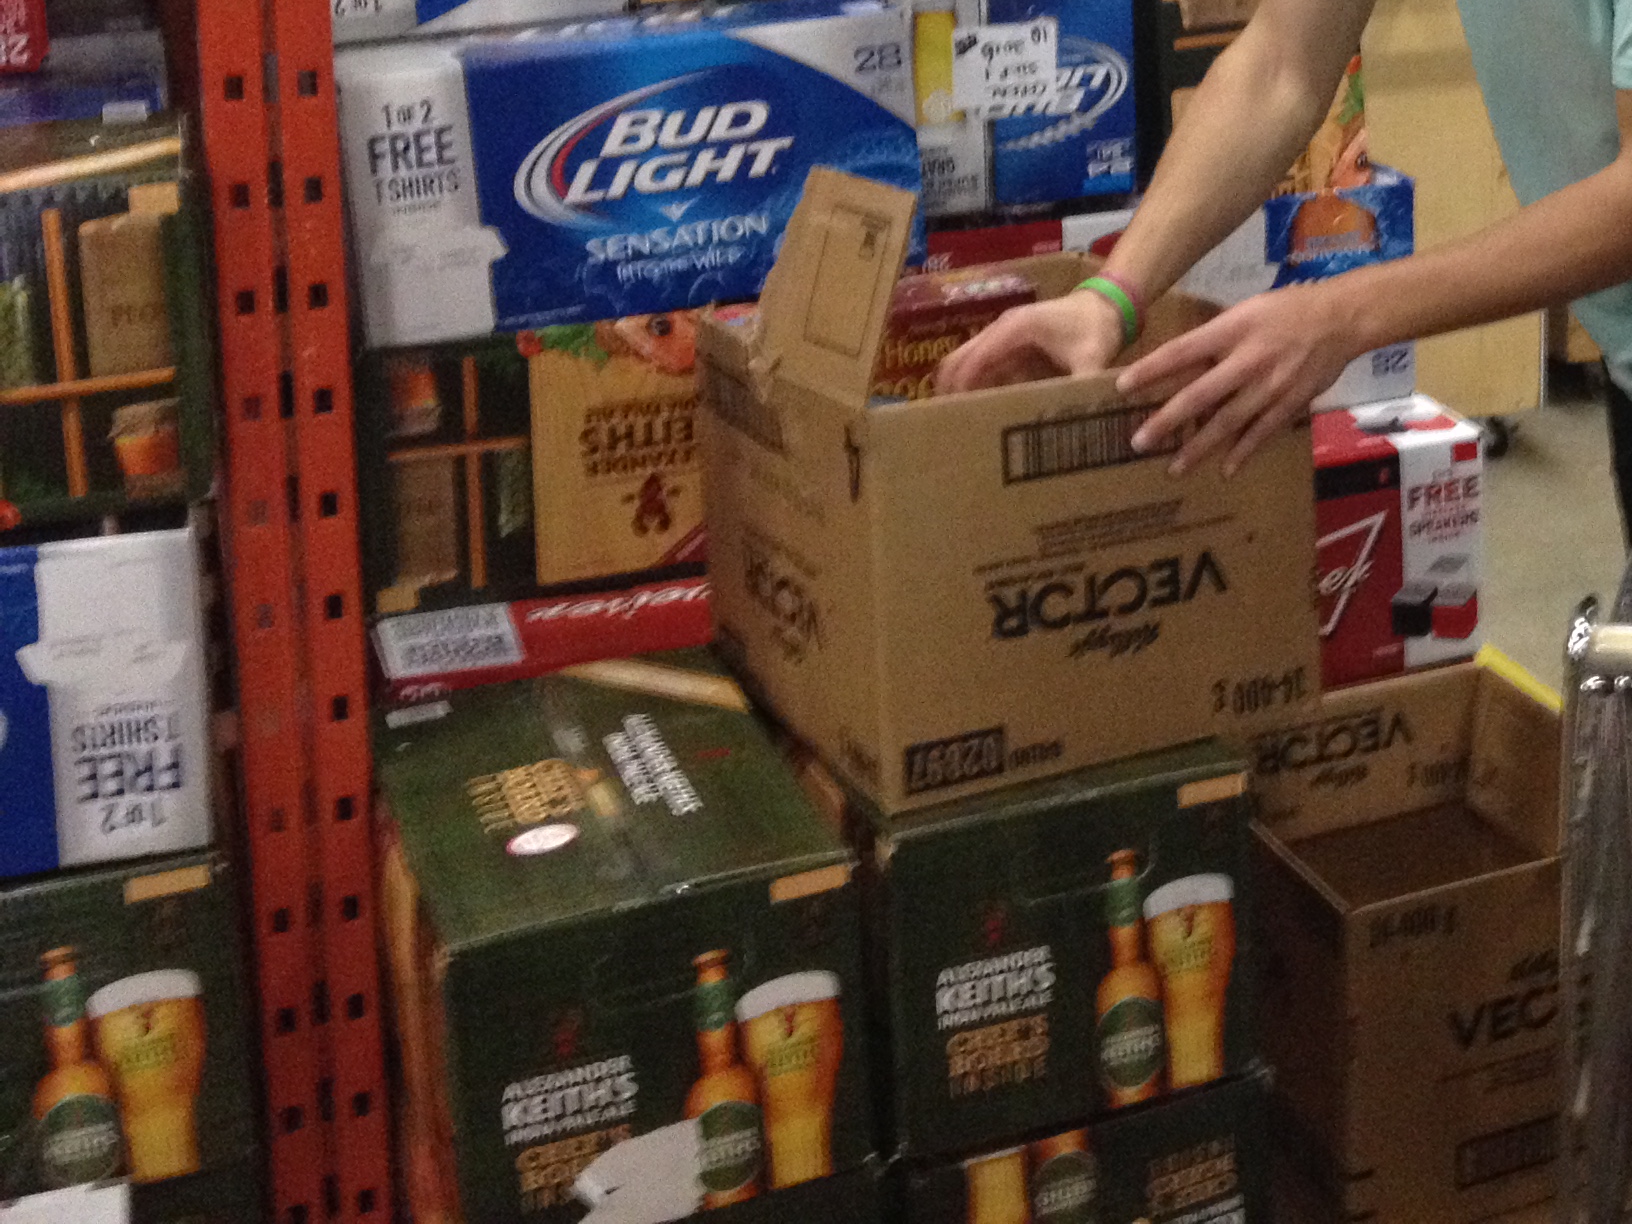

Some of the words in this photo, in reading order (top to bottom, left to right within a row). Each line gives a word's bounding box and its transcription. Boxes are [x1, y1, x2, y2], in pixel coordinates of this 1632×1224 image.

[854, 45, 902, 74] 28
[420, 98, 432, 124] 2
[600, 100, 771, 160] BUD
[366, 124, 456, 176] FREE
[563, 136, 795, 206] LIGHT
[387, 167, 461, 201] SHIRTS
[585, 213, 770, 264] SENSATION
[1406, 473, 1480, 511] FREE
[71, 715, 158, 753] SHIRTS
[74, 744, 184, 804] FREE
[99, 802, 116, 835] 2
[1449, 981, 1560, 1051] VEC
